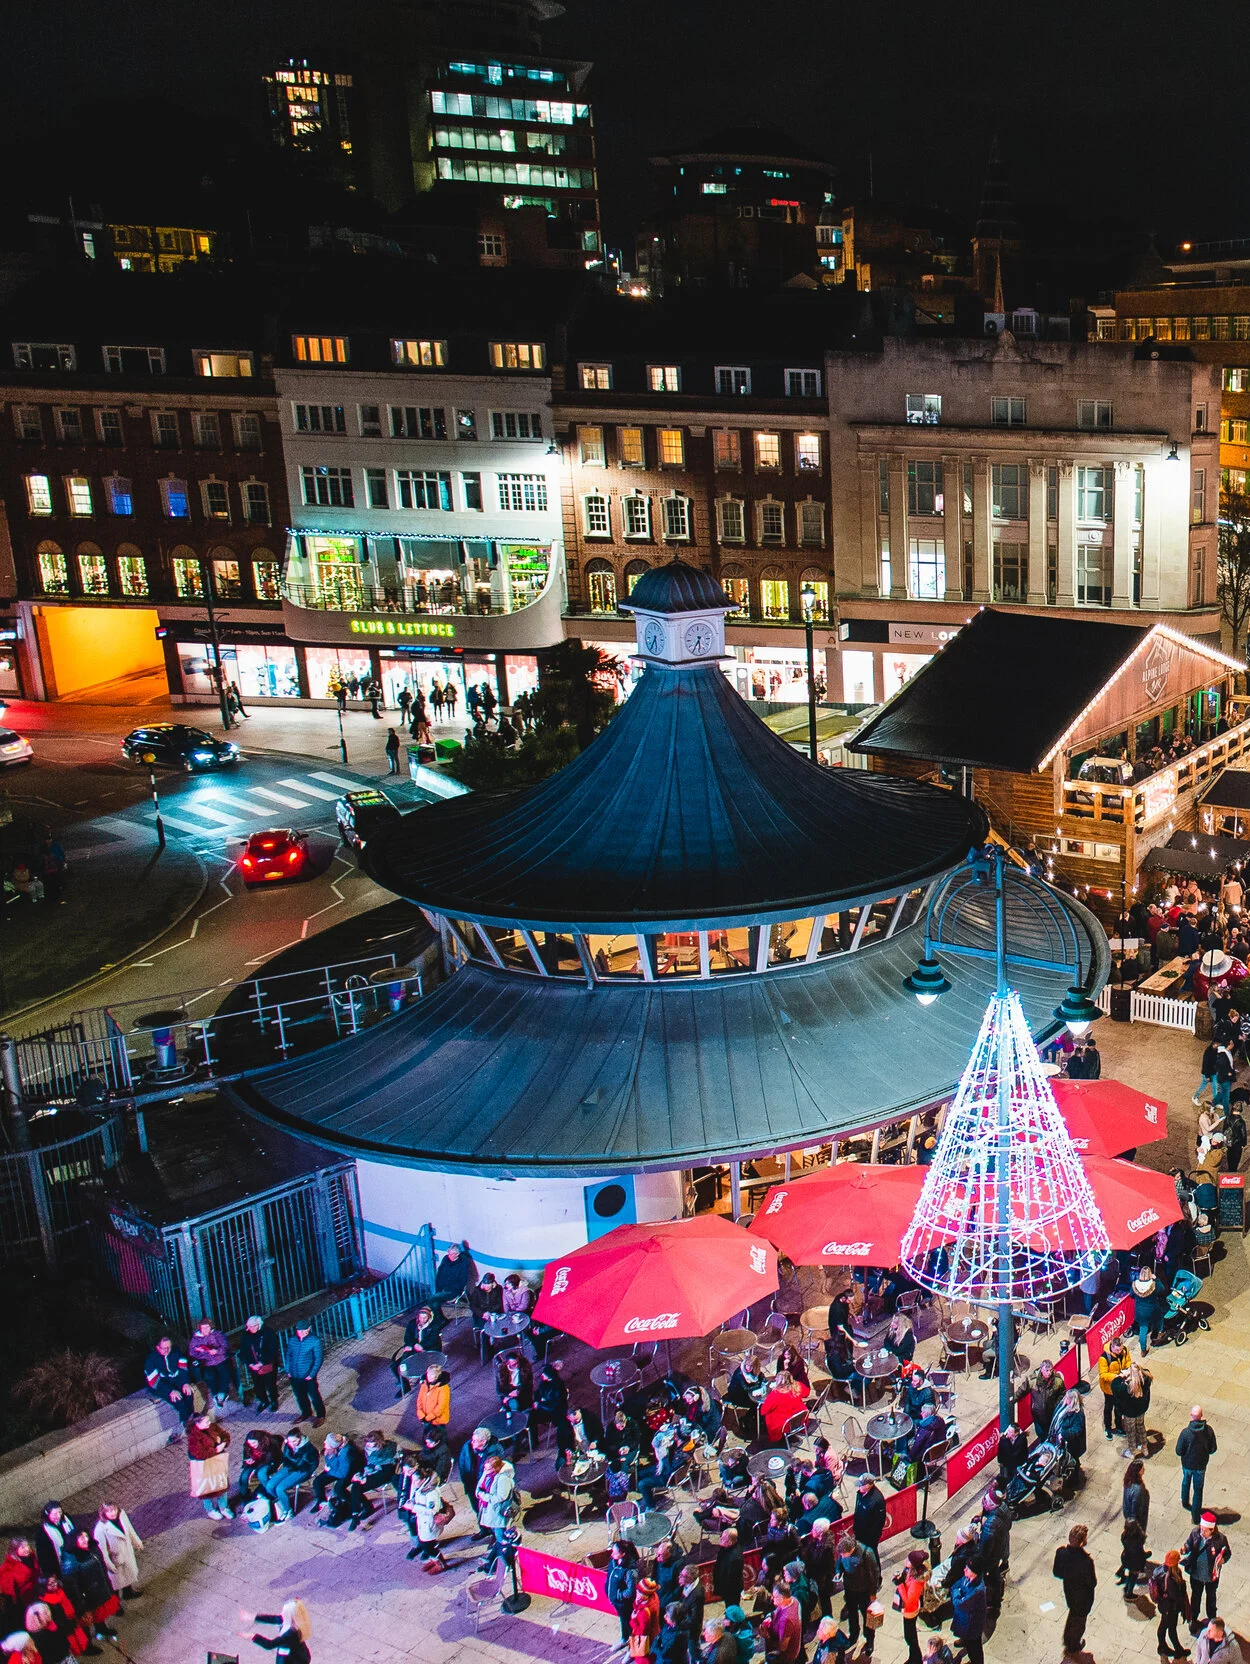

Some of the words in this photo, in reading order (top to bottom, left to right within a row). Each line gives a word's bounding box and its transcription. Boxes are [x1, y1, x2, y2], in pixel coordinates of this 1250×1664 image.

[386, 621, 395, 634] &
[397, 623, 455, 637] LETTUCE
[894, 630, 924, 639] NEW
[1127, 1208, 1160, 1233] Coca-Cola
[821, 1241, 874, 1256] Coca-Cola
[623, 1312, 681, 1333] Coca-Cola
